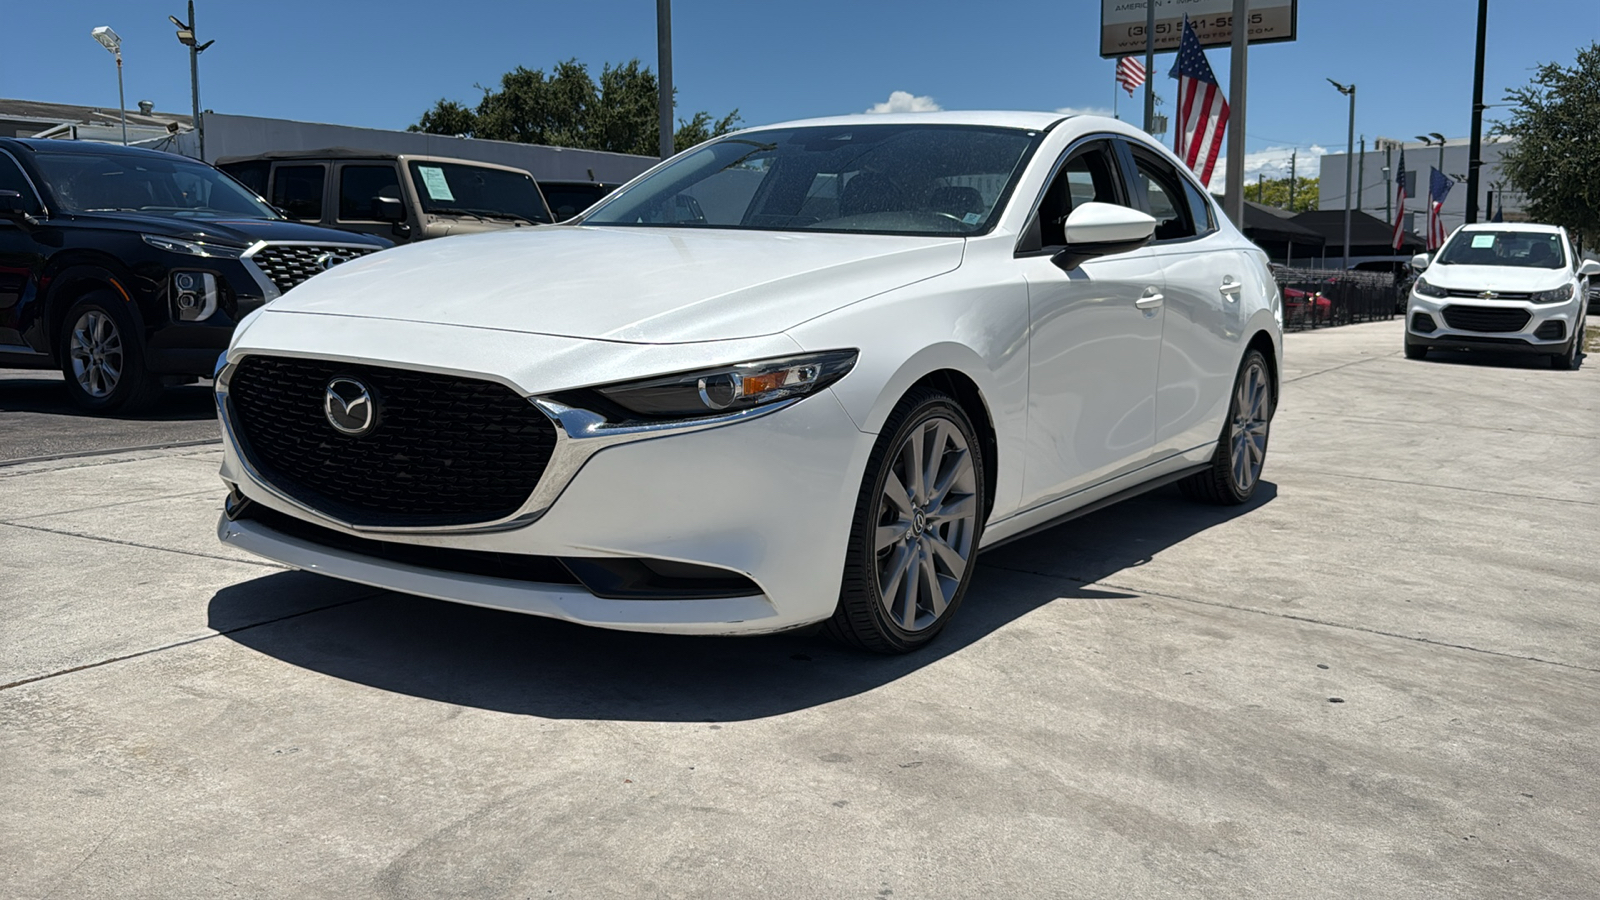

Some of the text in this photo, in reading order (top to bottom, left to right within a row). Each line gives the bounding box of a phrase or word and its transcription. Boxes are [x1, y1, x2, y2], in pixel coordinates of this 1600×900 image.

[1115, 1, 1162, 12] AMERICN
[1128, 13, 1263, 37] (35) 541-555
